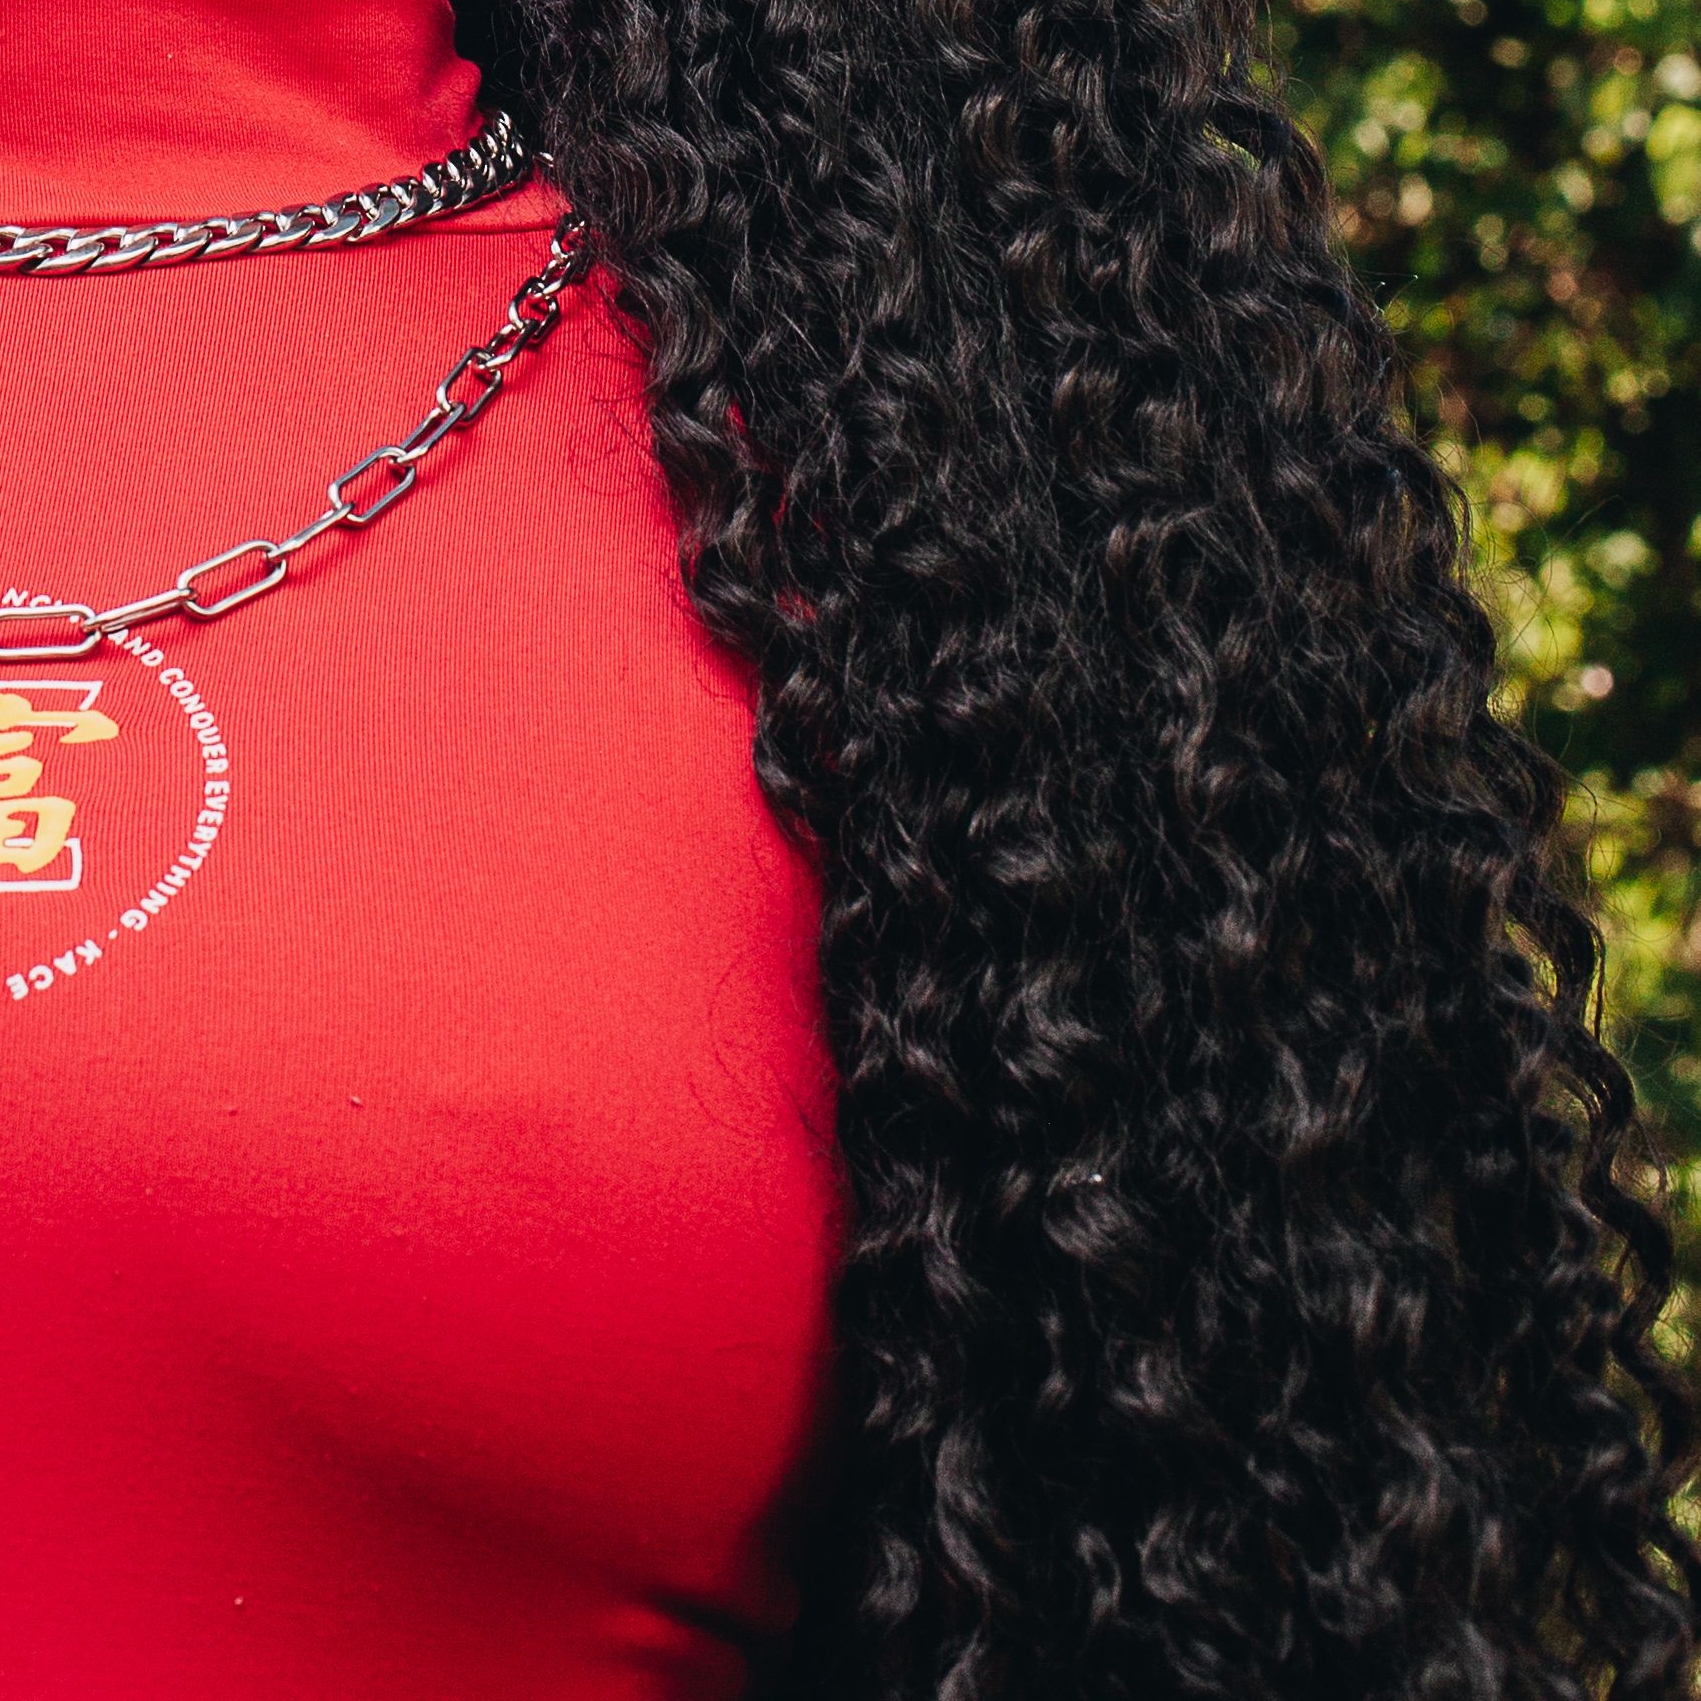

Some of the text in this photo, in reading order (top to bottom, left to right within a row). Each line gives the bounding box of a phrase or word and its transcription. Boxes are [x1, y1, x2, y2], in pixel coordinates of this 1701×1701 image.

[108, 627, 164, 668] AND
[158, 666, 229, 774] CONQUER
[119, 780, 230, 932] EVERYTHING
[5, 938, 103, 1000] KACE
